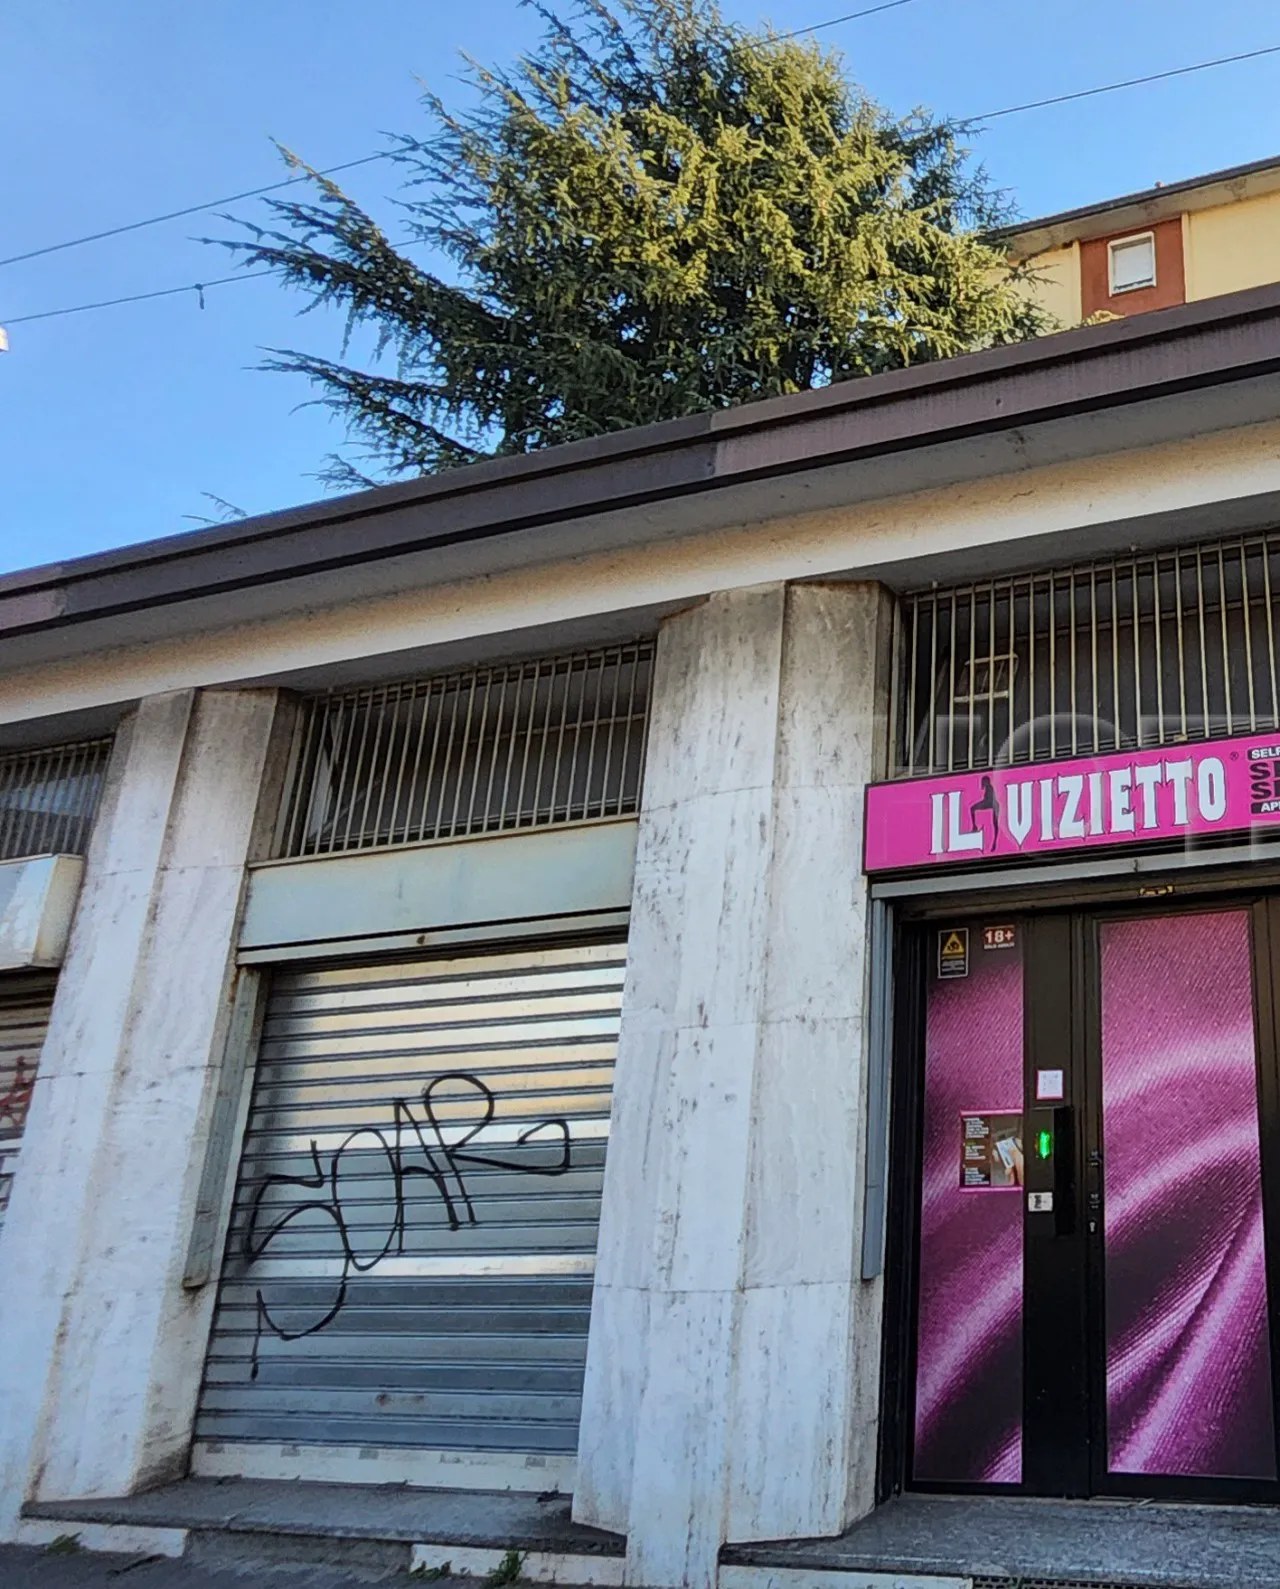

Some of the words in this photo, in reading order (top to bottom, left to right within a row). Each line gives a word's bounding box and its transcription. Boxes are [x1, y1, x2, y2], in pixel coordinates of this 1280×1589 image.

[929, 789, 984, 855] IL
[1005, 755, 1228, 849] VIZIETTO
[984, 929, 1015, 944] 18+
